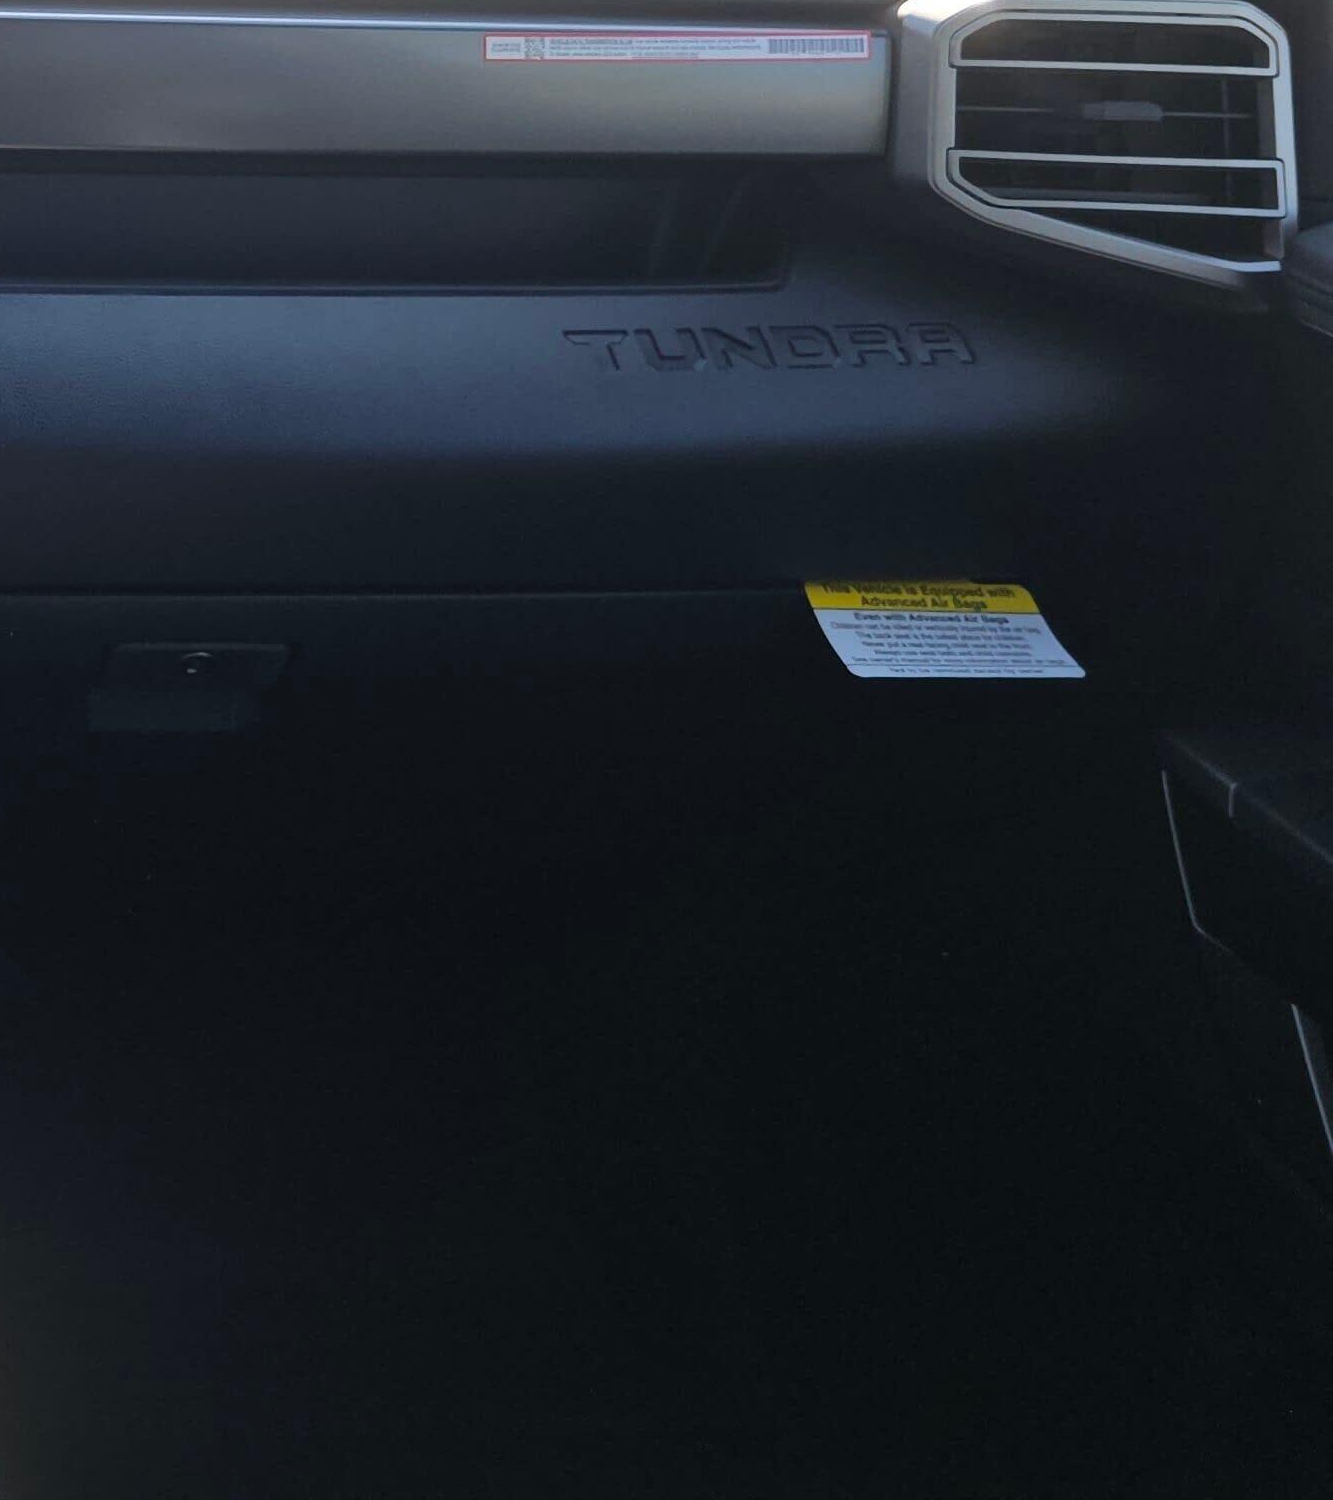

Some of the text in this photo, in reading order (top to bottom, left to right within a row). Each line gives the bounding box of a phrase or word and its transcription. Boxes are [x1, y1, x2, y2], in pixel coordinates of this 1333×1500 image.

[562, 322, 976, 372] TUNDRA
[861, 595, 988, 611] Advanced Air Bags
[909, 613, 961, 622] Advanced
